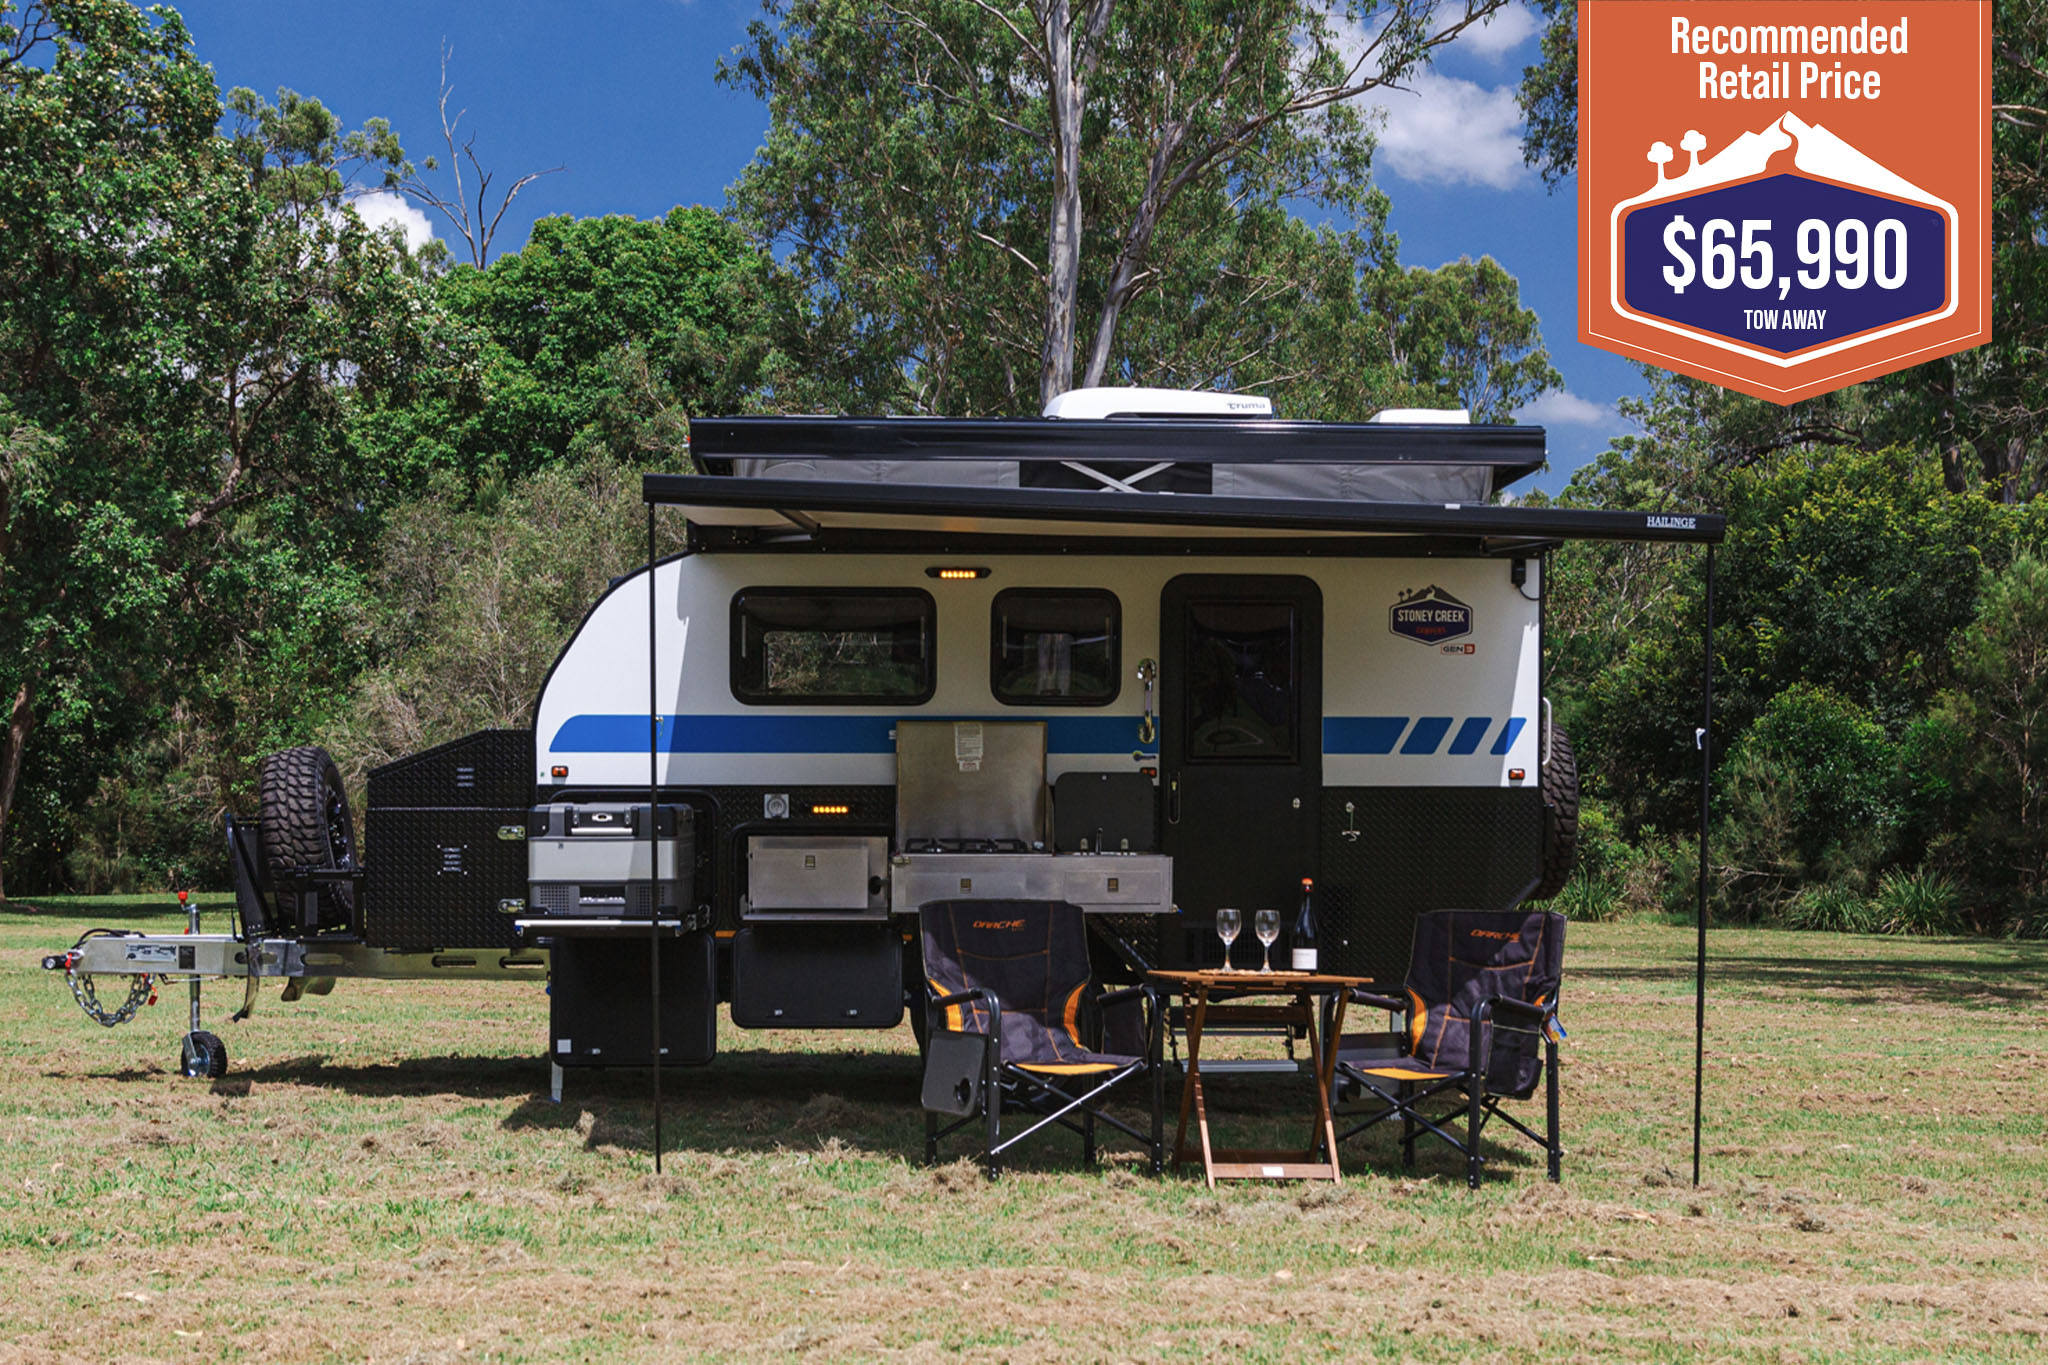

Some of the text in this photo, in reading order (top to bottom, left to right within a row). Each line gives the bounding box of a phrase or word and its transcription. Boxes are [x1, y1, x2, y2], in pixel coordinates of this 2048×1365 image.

[1646, 515, 1697, 530] HAILINGE
[1397, 609, 1465, 623] STONEY CREEK
